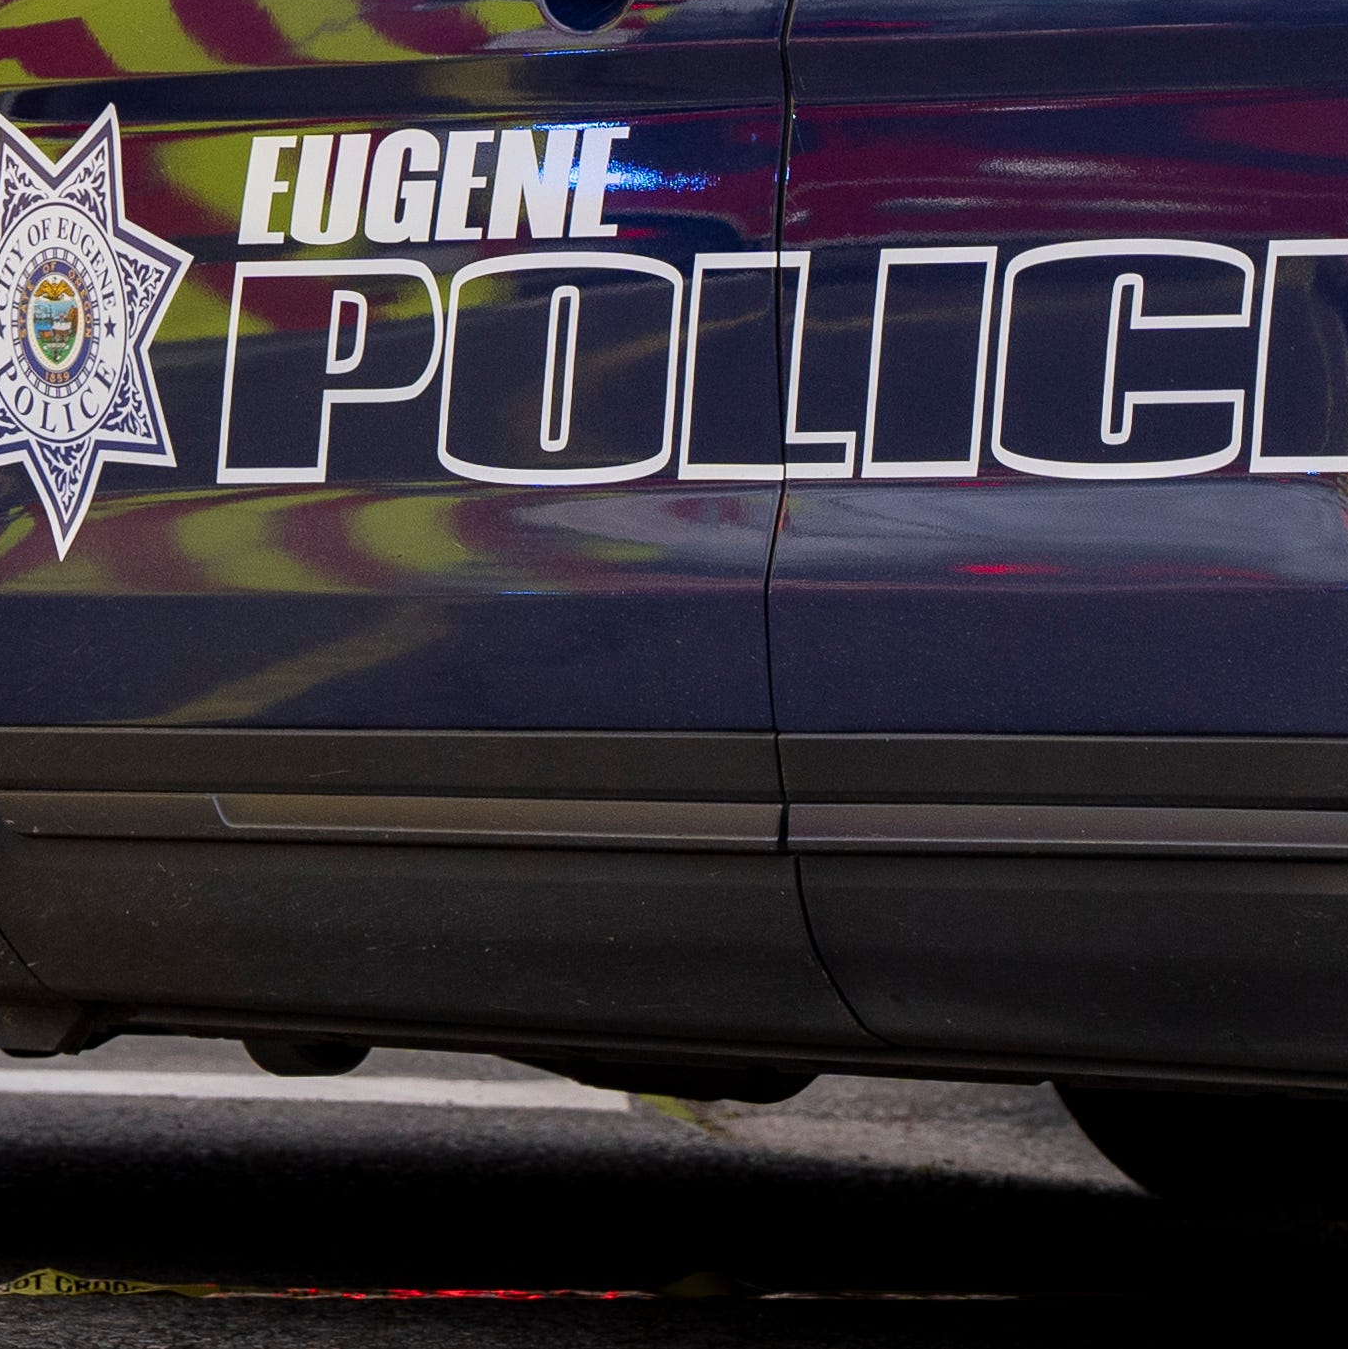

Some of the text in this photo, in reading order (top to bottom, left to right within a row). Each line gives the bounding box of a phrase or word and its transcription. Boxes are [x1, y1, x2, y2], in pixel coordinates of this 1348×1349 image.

[237, 126, 630, 245] EUGENE
[27, 217, 52, 247] OF
[57, 217, 116, 312] EUGENE
[42, 261, 57, 273] OF
[44, 371, 70, 384] 1859
